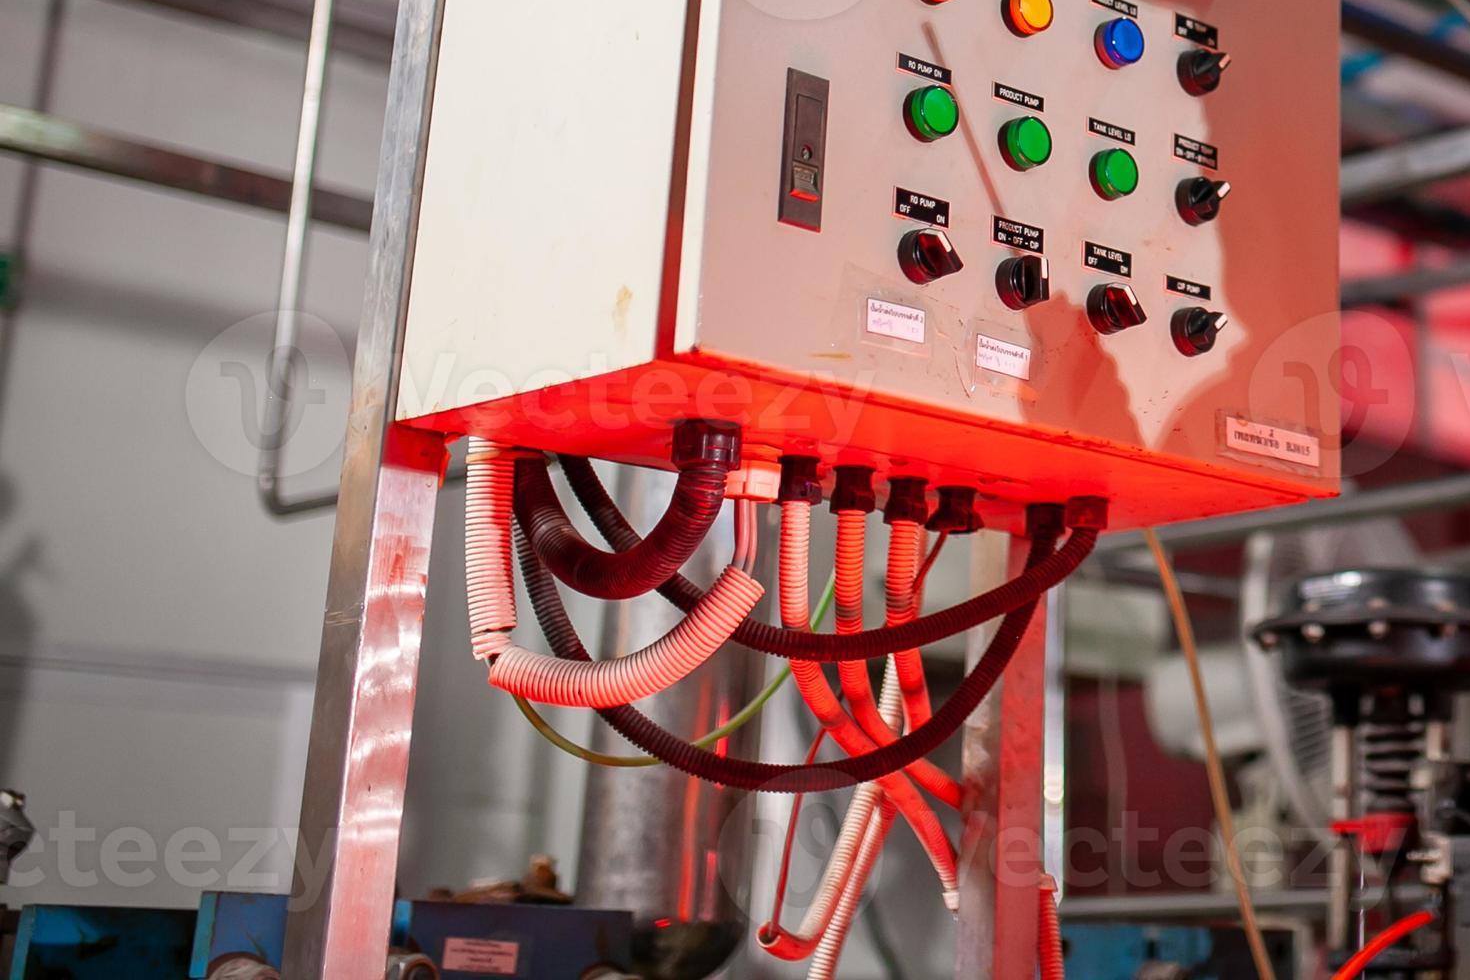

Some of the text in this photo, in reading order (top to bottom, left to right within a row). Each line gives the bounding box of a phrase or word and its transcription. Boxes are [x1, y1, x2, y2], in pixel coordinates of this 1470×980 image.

[917, 63, 933, 75] PUMP
[933, 68, 943, 79] ON
[999, 87, 1040, 107] PRODUCT PUMP
[1093, 122, 1107, 133] TANK
[1108, 127, 1123, 139] LEVEL
[919, 197, 936, 209] PUMP
[899, 204, 945, 224] OFF ON
[998, 220, 1039, 238] PRODUCT PUMP
[997, 233, 1007, 242] ON
[1012, 236, 1024, 246] OFF
[1093, 246, 1124, 263] TANK LEVEL
[1087, 256, 1129, 274] OFF ON
[1186, 283, 1201, 295] PUMP
